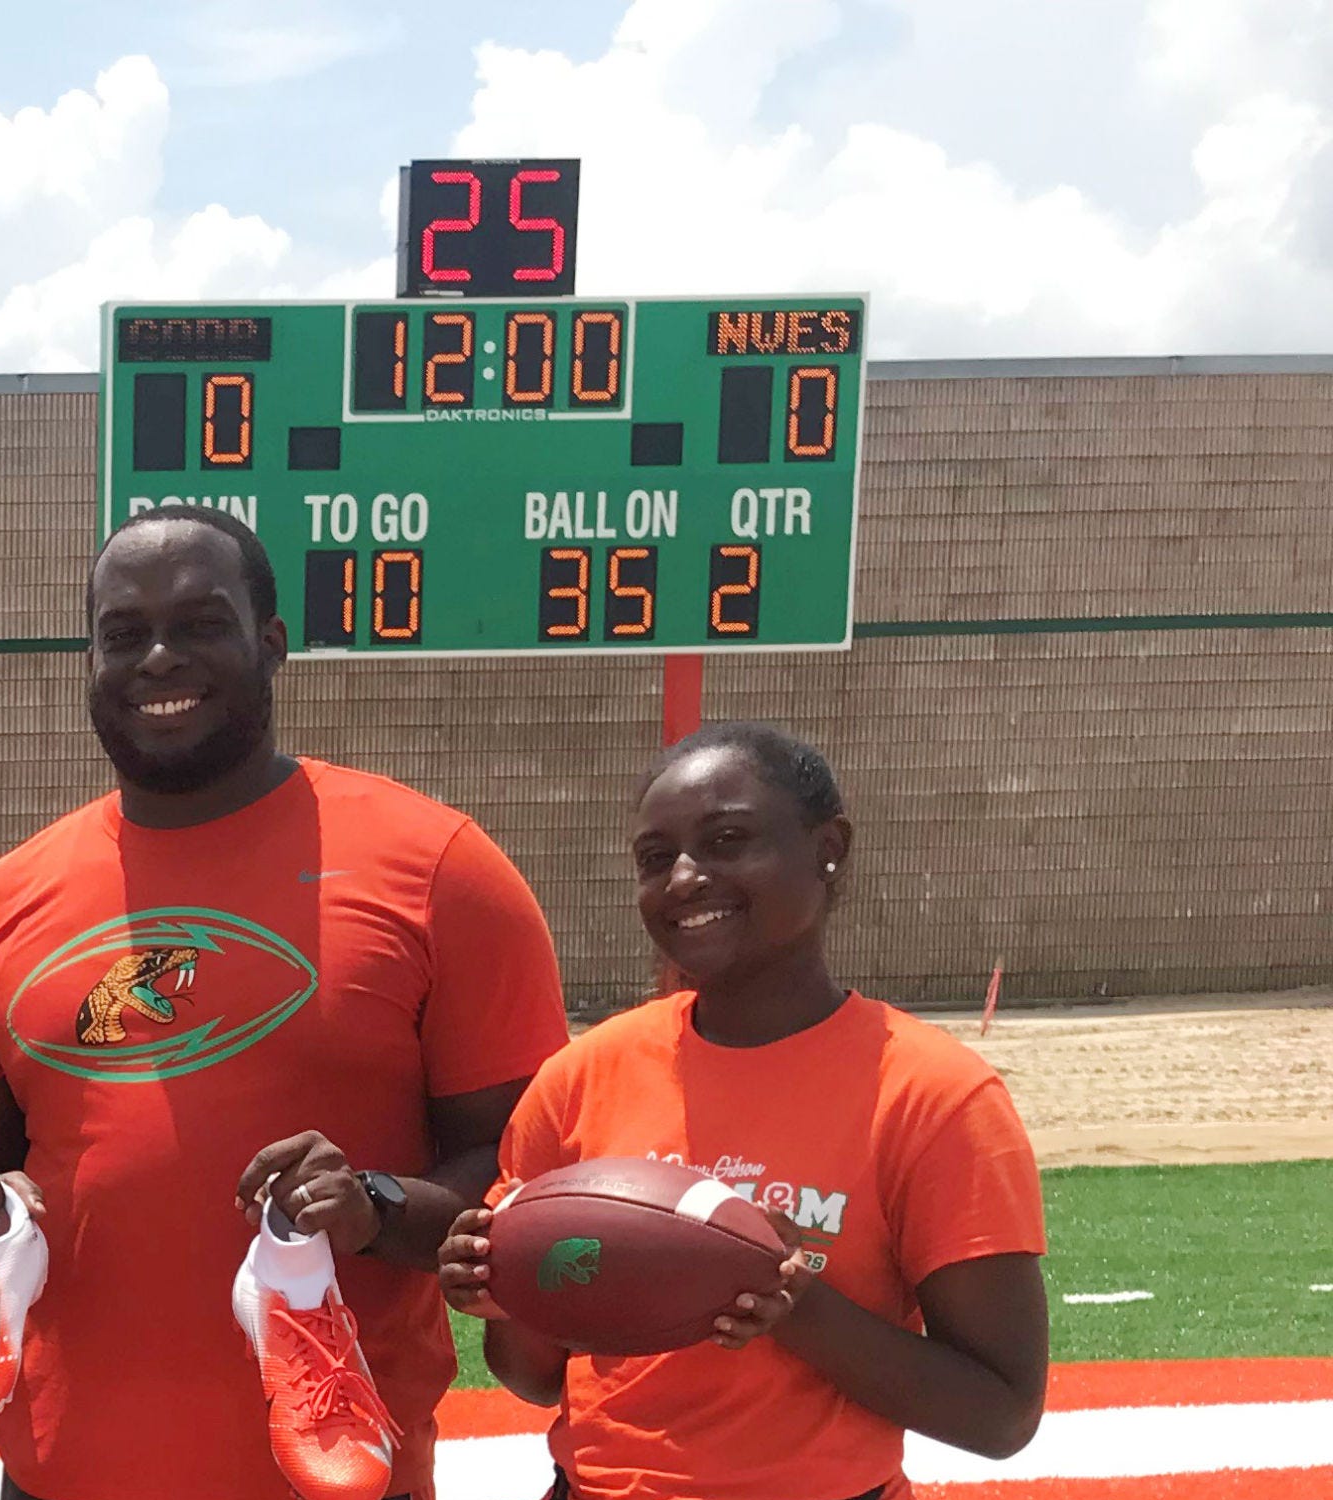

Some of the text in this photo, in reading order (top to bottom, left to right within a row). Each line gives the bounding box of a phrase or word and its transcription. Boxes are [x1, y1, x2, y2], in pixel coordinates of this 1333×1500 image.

[422, 170, 565, 282] 25
[394, 313, 620, 402] 12:00
[205, 375, 251, 463] 0
[426, 408, 549, 422] DAKTRONICS
[788, 368, 836, 455] 0
[304, 493, 429, 542] TO GO
[524, 489, 678, 539] BALL ON
[730, 487, 812, 539] QTR
[342, 552, 420, 638] 10
[546, 549, 652, 635] 35
[711, 546, 759, 632] 2
